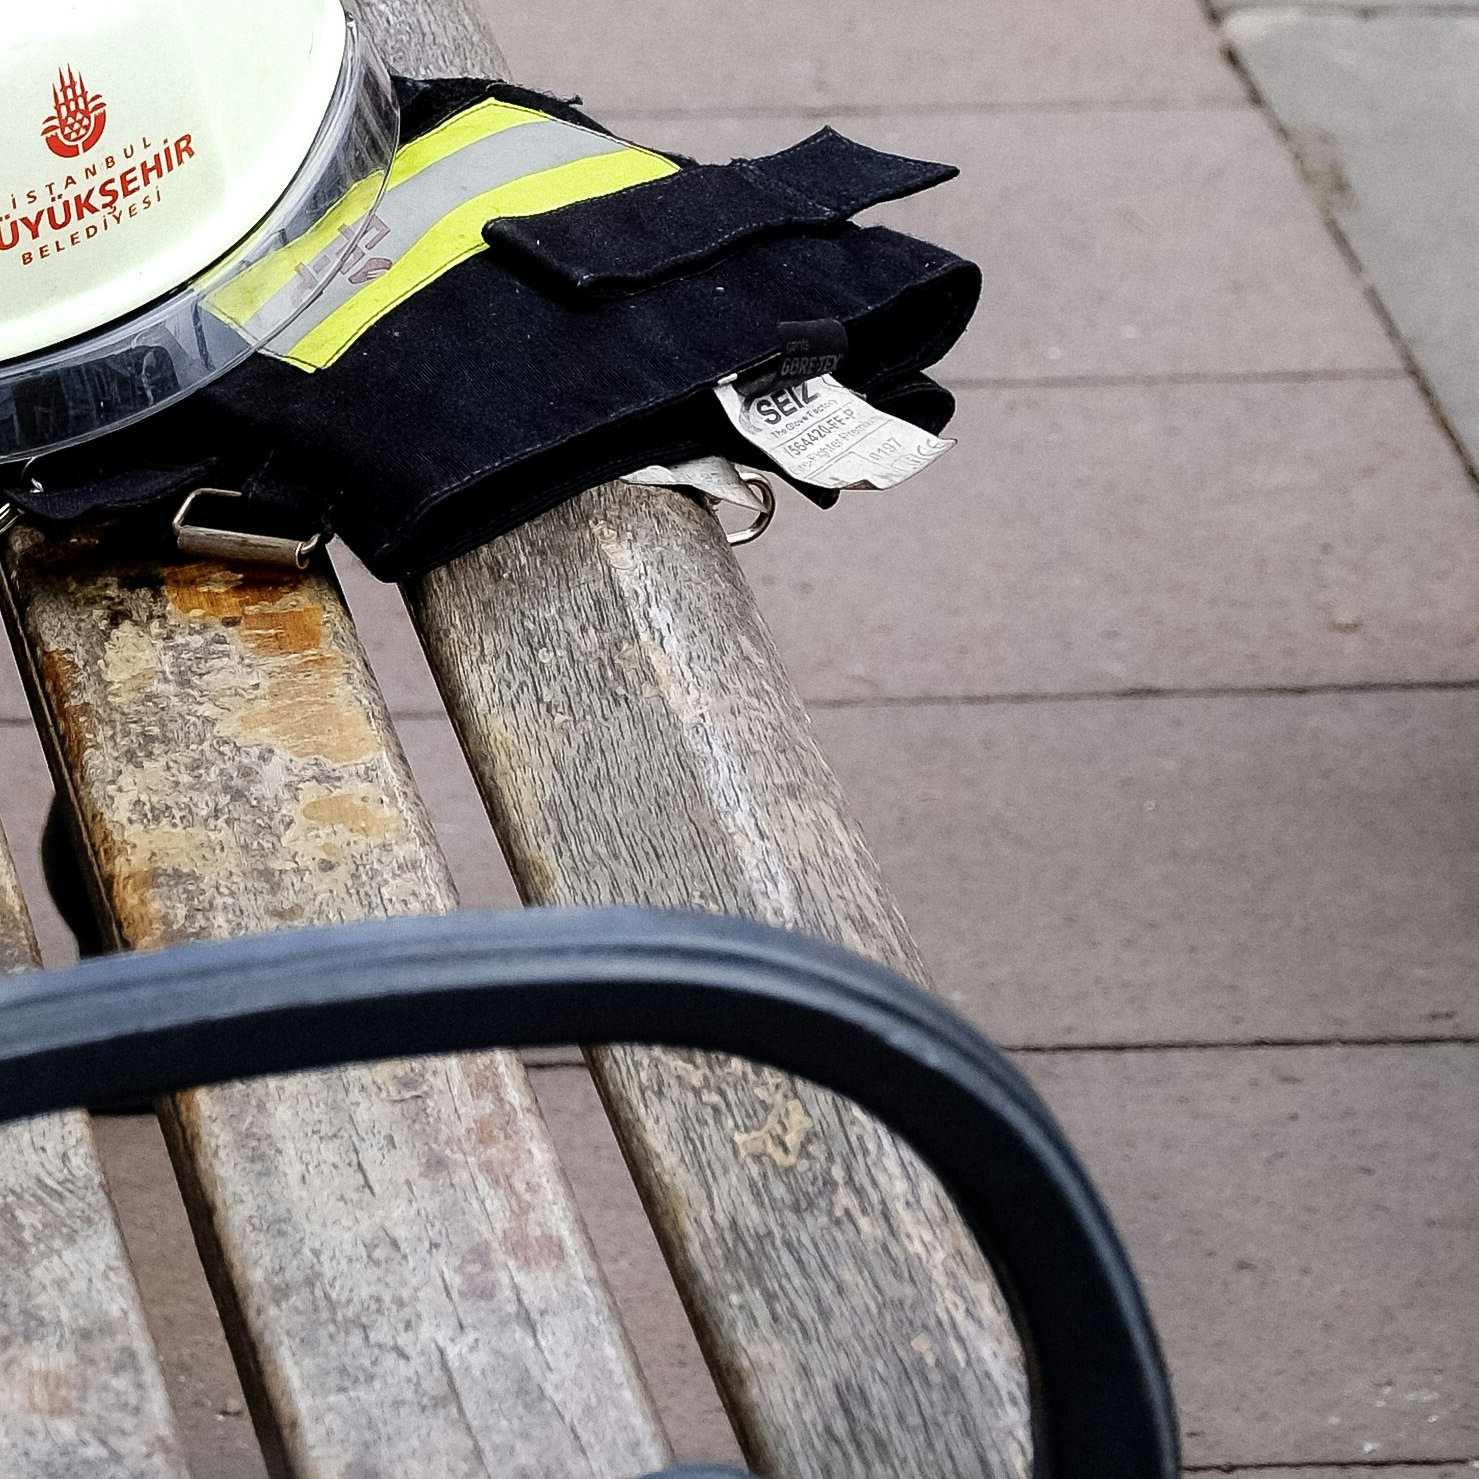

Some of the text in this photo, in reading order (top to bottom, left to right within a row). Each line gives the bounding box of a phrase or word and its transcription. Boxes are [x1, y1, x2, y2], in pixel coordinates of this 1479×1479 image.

[10, 136, 152, 209] İSTANBUL
[21, 186, 162, 266] BELEDİYESİ
[781, 354, 841, 376] GORE-TEX
[756, 380, 821, 425] SEIZ
[770, 428, 787, 439] The
[868, 436, 902, 461] 0197
